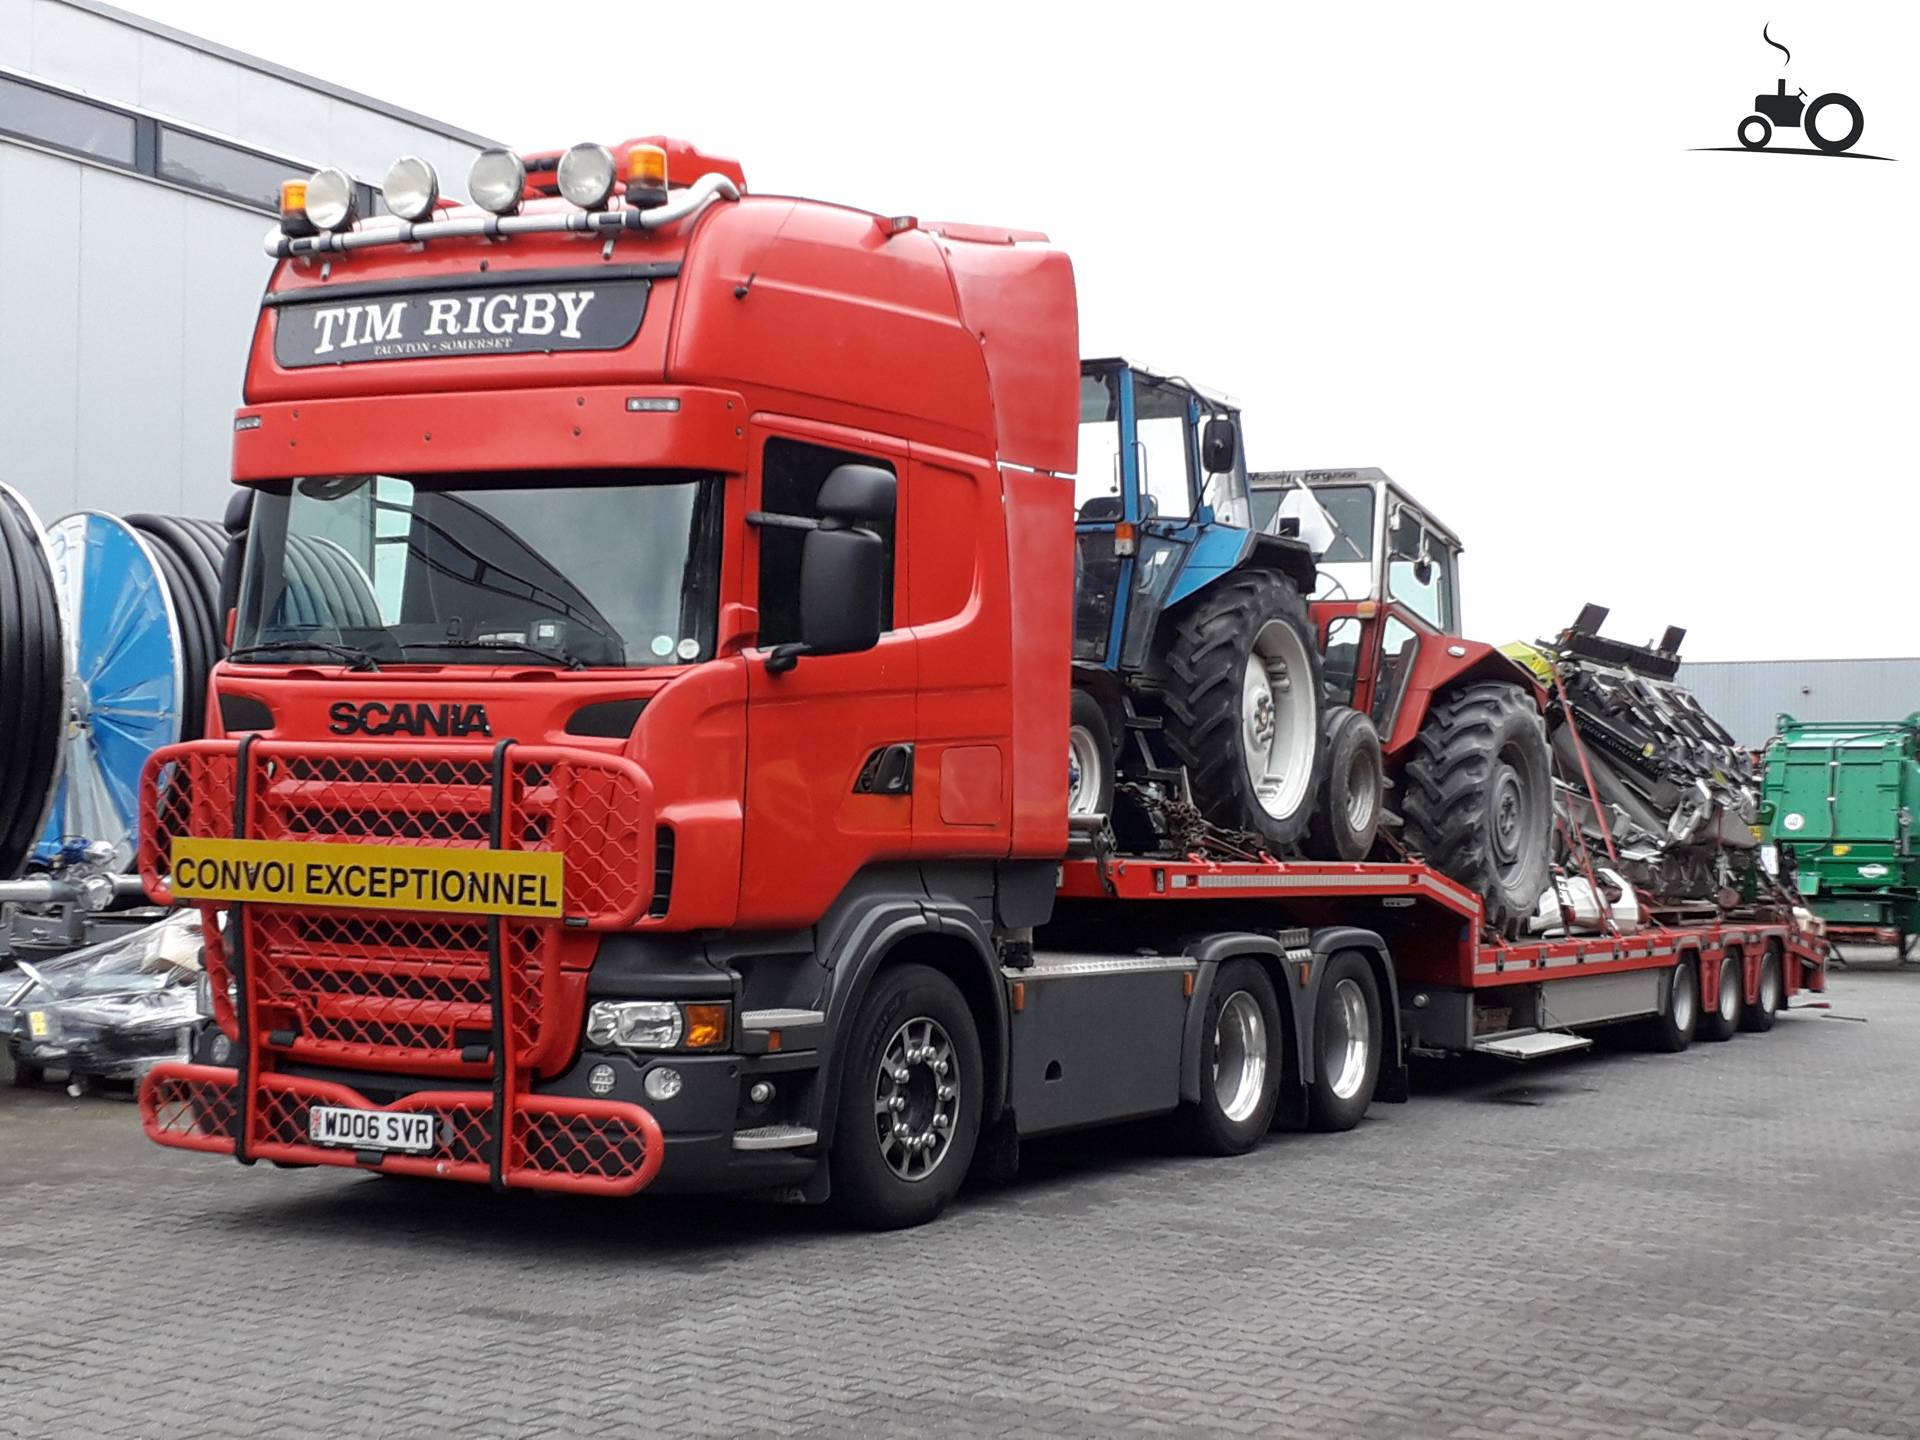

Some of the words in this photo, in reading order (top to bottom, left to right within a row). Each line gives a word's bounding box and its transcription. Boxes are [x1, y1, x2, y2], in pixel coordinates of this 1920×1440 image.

[314, 302, 407, 354] TIM
[424, 291, 594, 339] RIGBY
[374, 342, 430, 356] TAUNTON
[439, 337, 513, 351] SOMERSET
[329, 702, 493, 737] SCANIA
[175, 857, 294, 893] CONVOI
[305, 863, 558, 908] EXCEPTIONNEL
[325, 1111, 380, 1139] WD06
[387, 1117, 428, 1144] SVR
